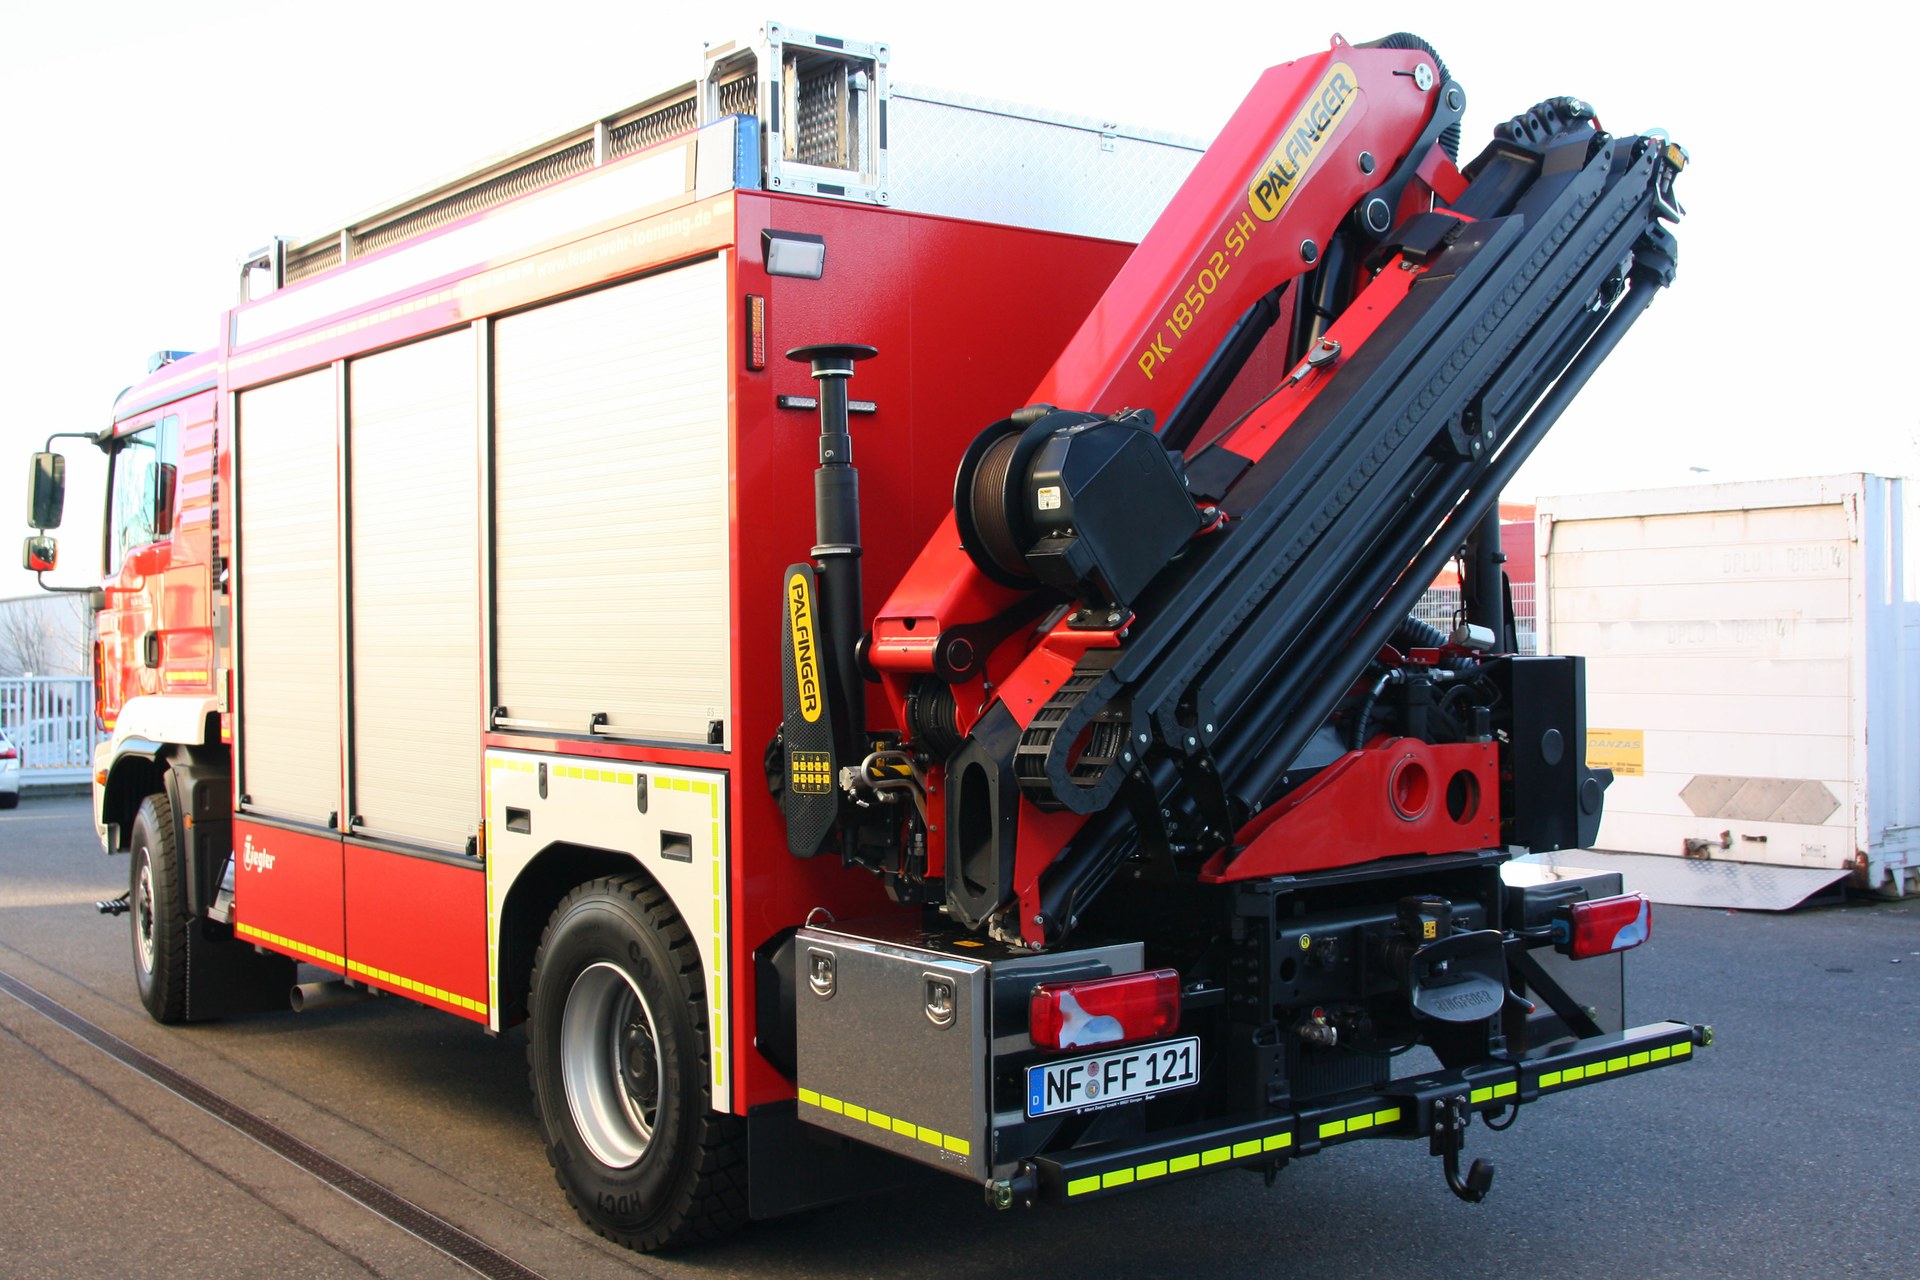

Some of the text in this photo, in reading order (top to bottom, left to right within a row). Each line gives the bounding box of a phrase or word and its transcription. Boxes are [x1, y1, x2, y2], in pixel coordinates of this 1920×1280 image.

[1255, 71, 1353, 212] PALFINGER
[1137, 332, 1173, 380] PK
[792, 583, 817, 713] PALFINGER
[1588, 739, 1641, 749] DANZAS
[243, 834, 276, 874] Ziegler
[1434, 990, 1493, 1012] RINGFEDER
[1032, 1046, 1194, 1107] D NF FF 121
[597, 1190, 642, 1215] HDC1
